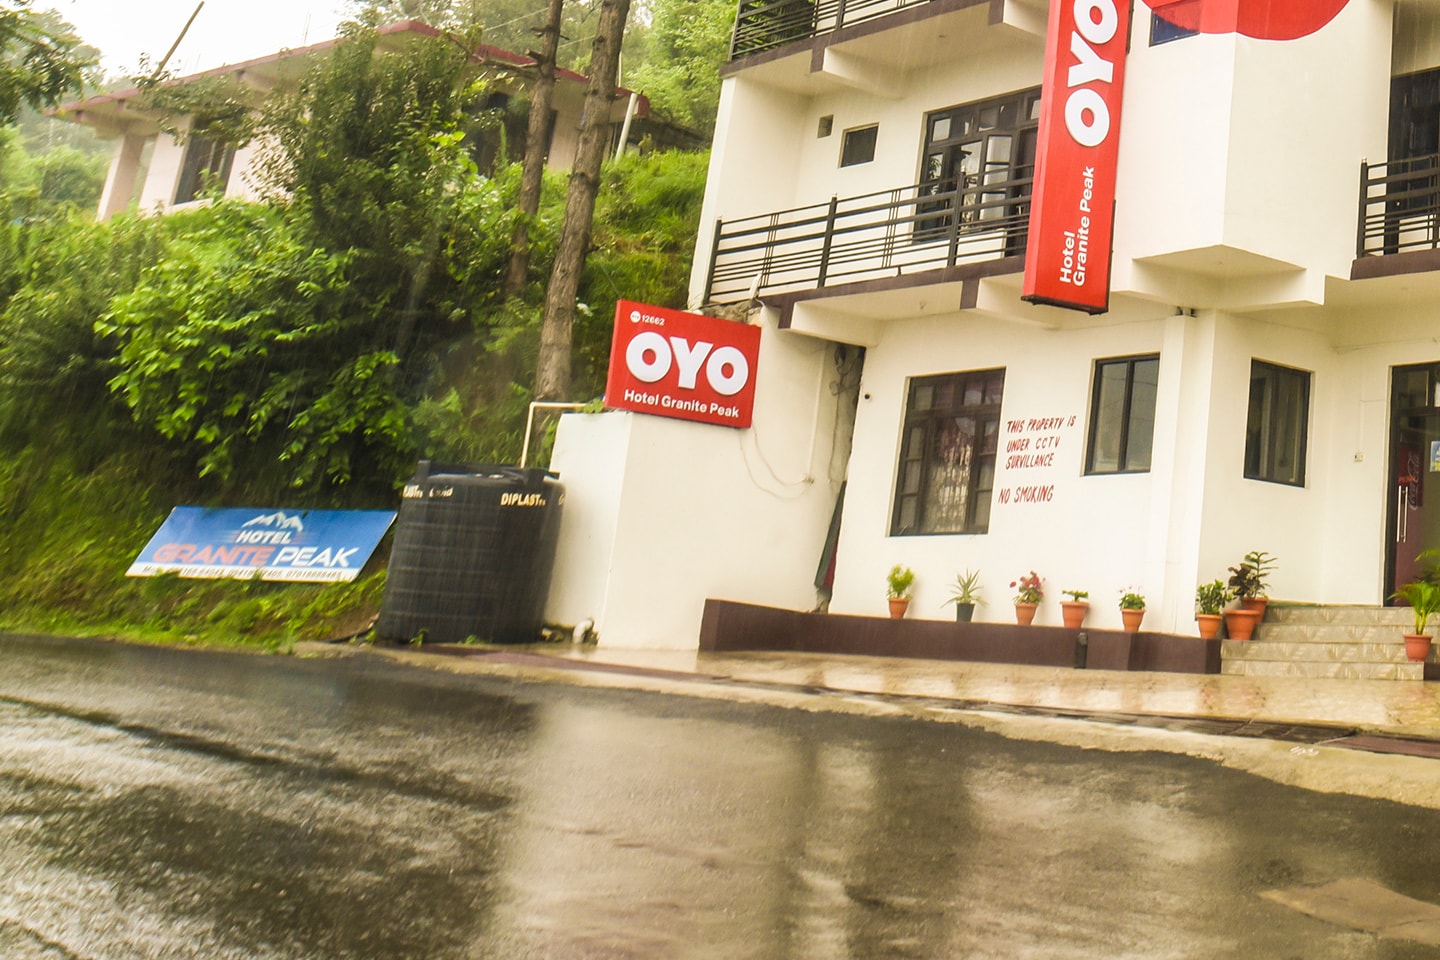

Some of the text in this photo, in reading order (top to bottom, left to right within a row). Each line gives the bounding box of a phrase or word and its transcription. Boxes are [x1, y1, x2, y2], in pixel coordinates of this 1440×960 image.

[1073, 166, 1095, 287] Granite Peak
[1059, 230, 1076, 284] Hotel
[642, 314, 665, 326] 12662
[625, 331, 749, 397] OYO
[624, 389, 740, 418] Hotel Granite Peak
[1006, 415, 1077, 434] THIS PROPERTY IS
[1006, 438, 1031, 453] UNDER
[1005, 452, 1055, 470] SURVILLANCE
[998, 484, 1055, 505] NO SMOKING
[235, 530, 293, 545] HOTEL
[153, 543, 360, 568] GRANITE PEAK
